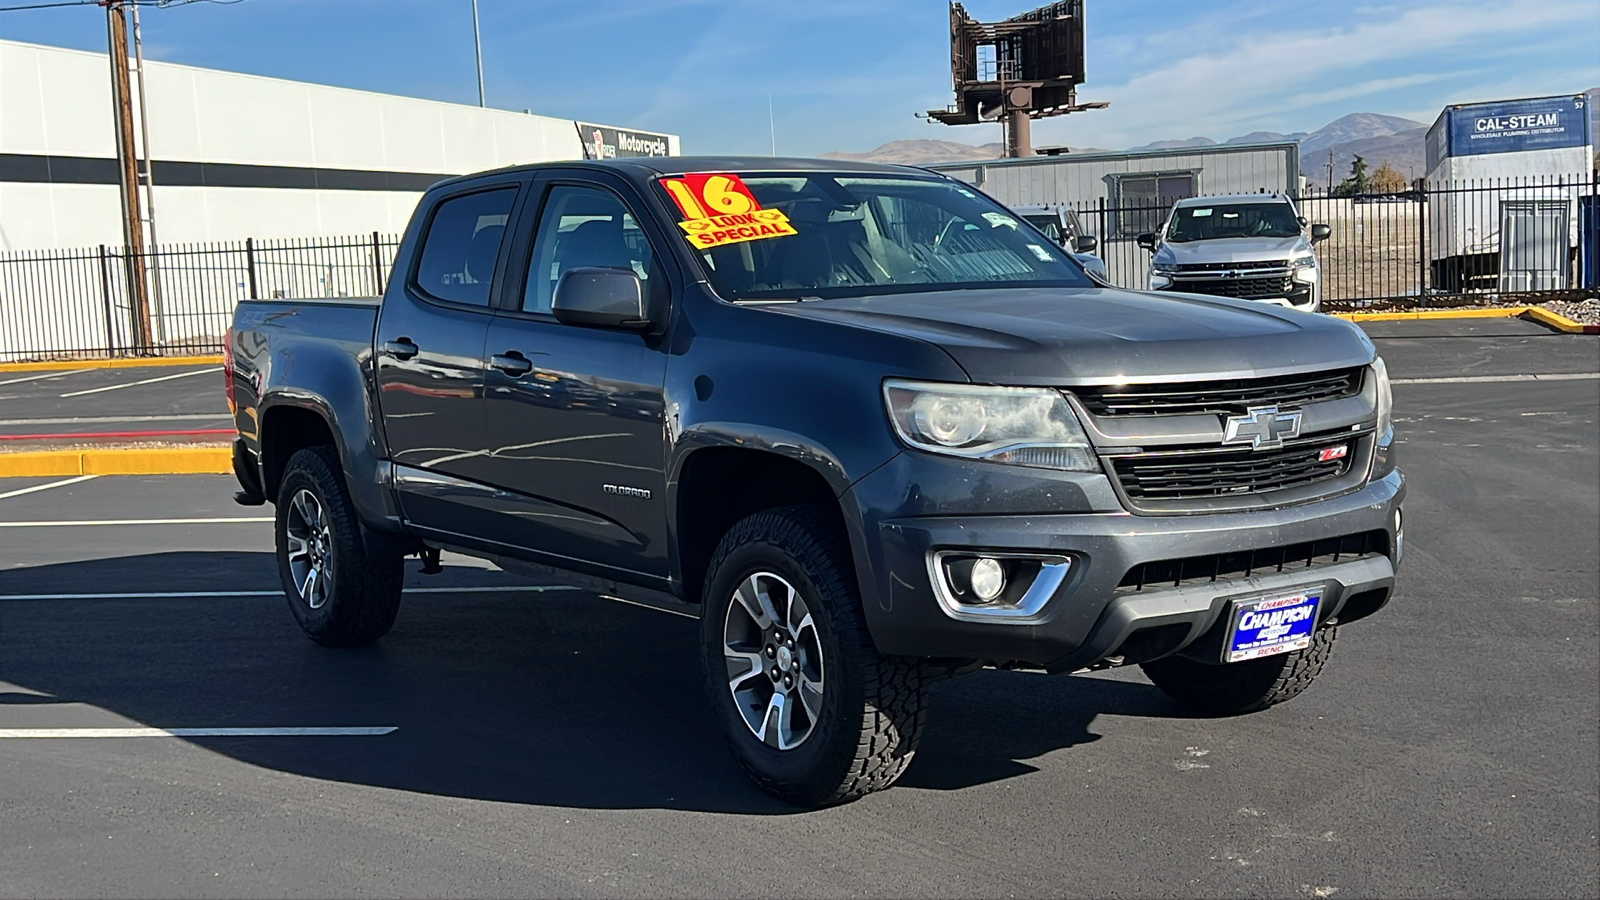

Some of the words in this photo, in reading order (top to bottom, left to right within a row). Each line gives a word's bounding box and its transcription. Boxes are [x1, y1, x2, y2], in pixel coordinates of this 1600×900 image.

[1476, 112, 1557, 131] CAL-STEAM
[1470, 132, 1502, 140] WHOLESALE
[1503, 129, 1530, 137] PLUMBING
[1531, 126, 1565, 135] DISTRIBUTOR
[618, 132, 666, 157] Motorcycle
[666, 175, 755, 219] 16
[710, 213, 760, 228] LOOK
[698, 223, 789, 245] SPECIAL
[603, 484, 651, 499] COLORADO
[1260, 595, 1302, 610] CHAMPION
[1239, 604, 1314, 631] CHAMPION
[1257, 645, 1284, 656] RENO
